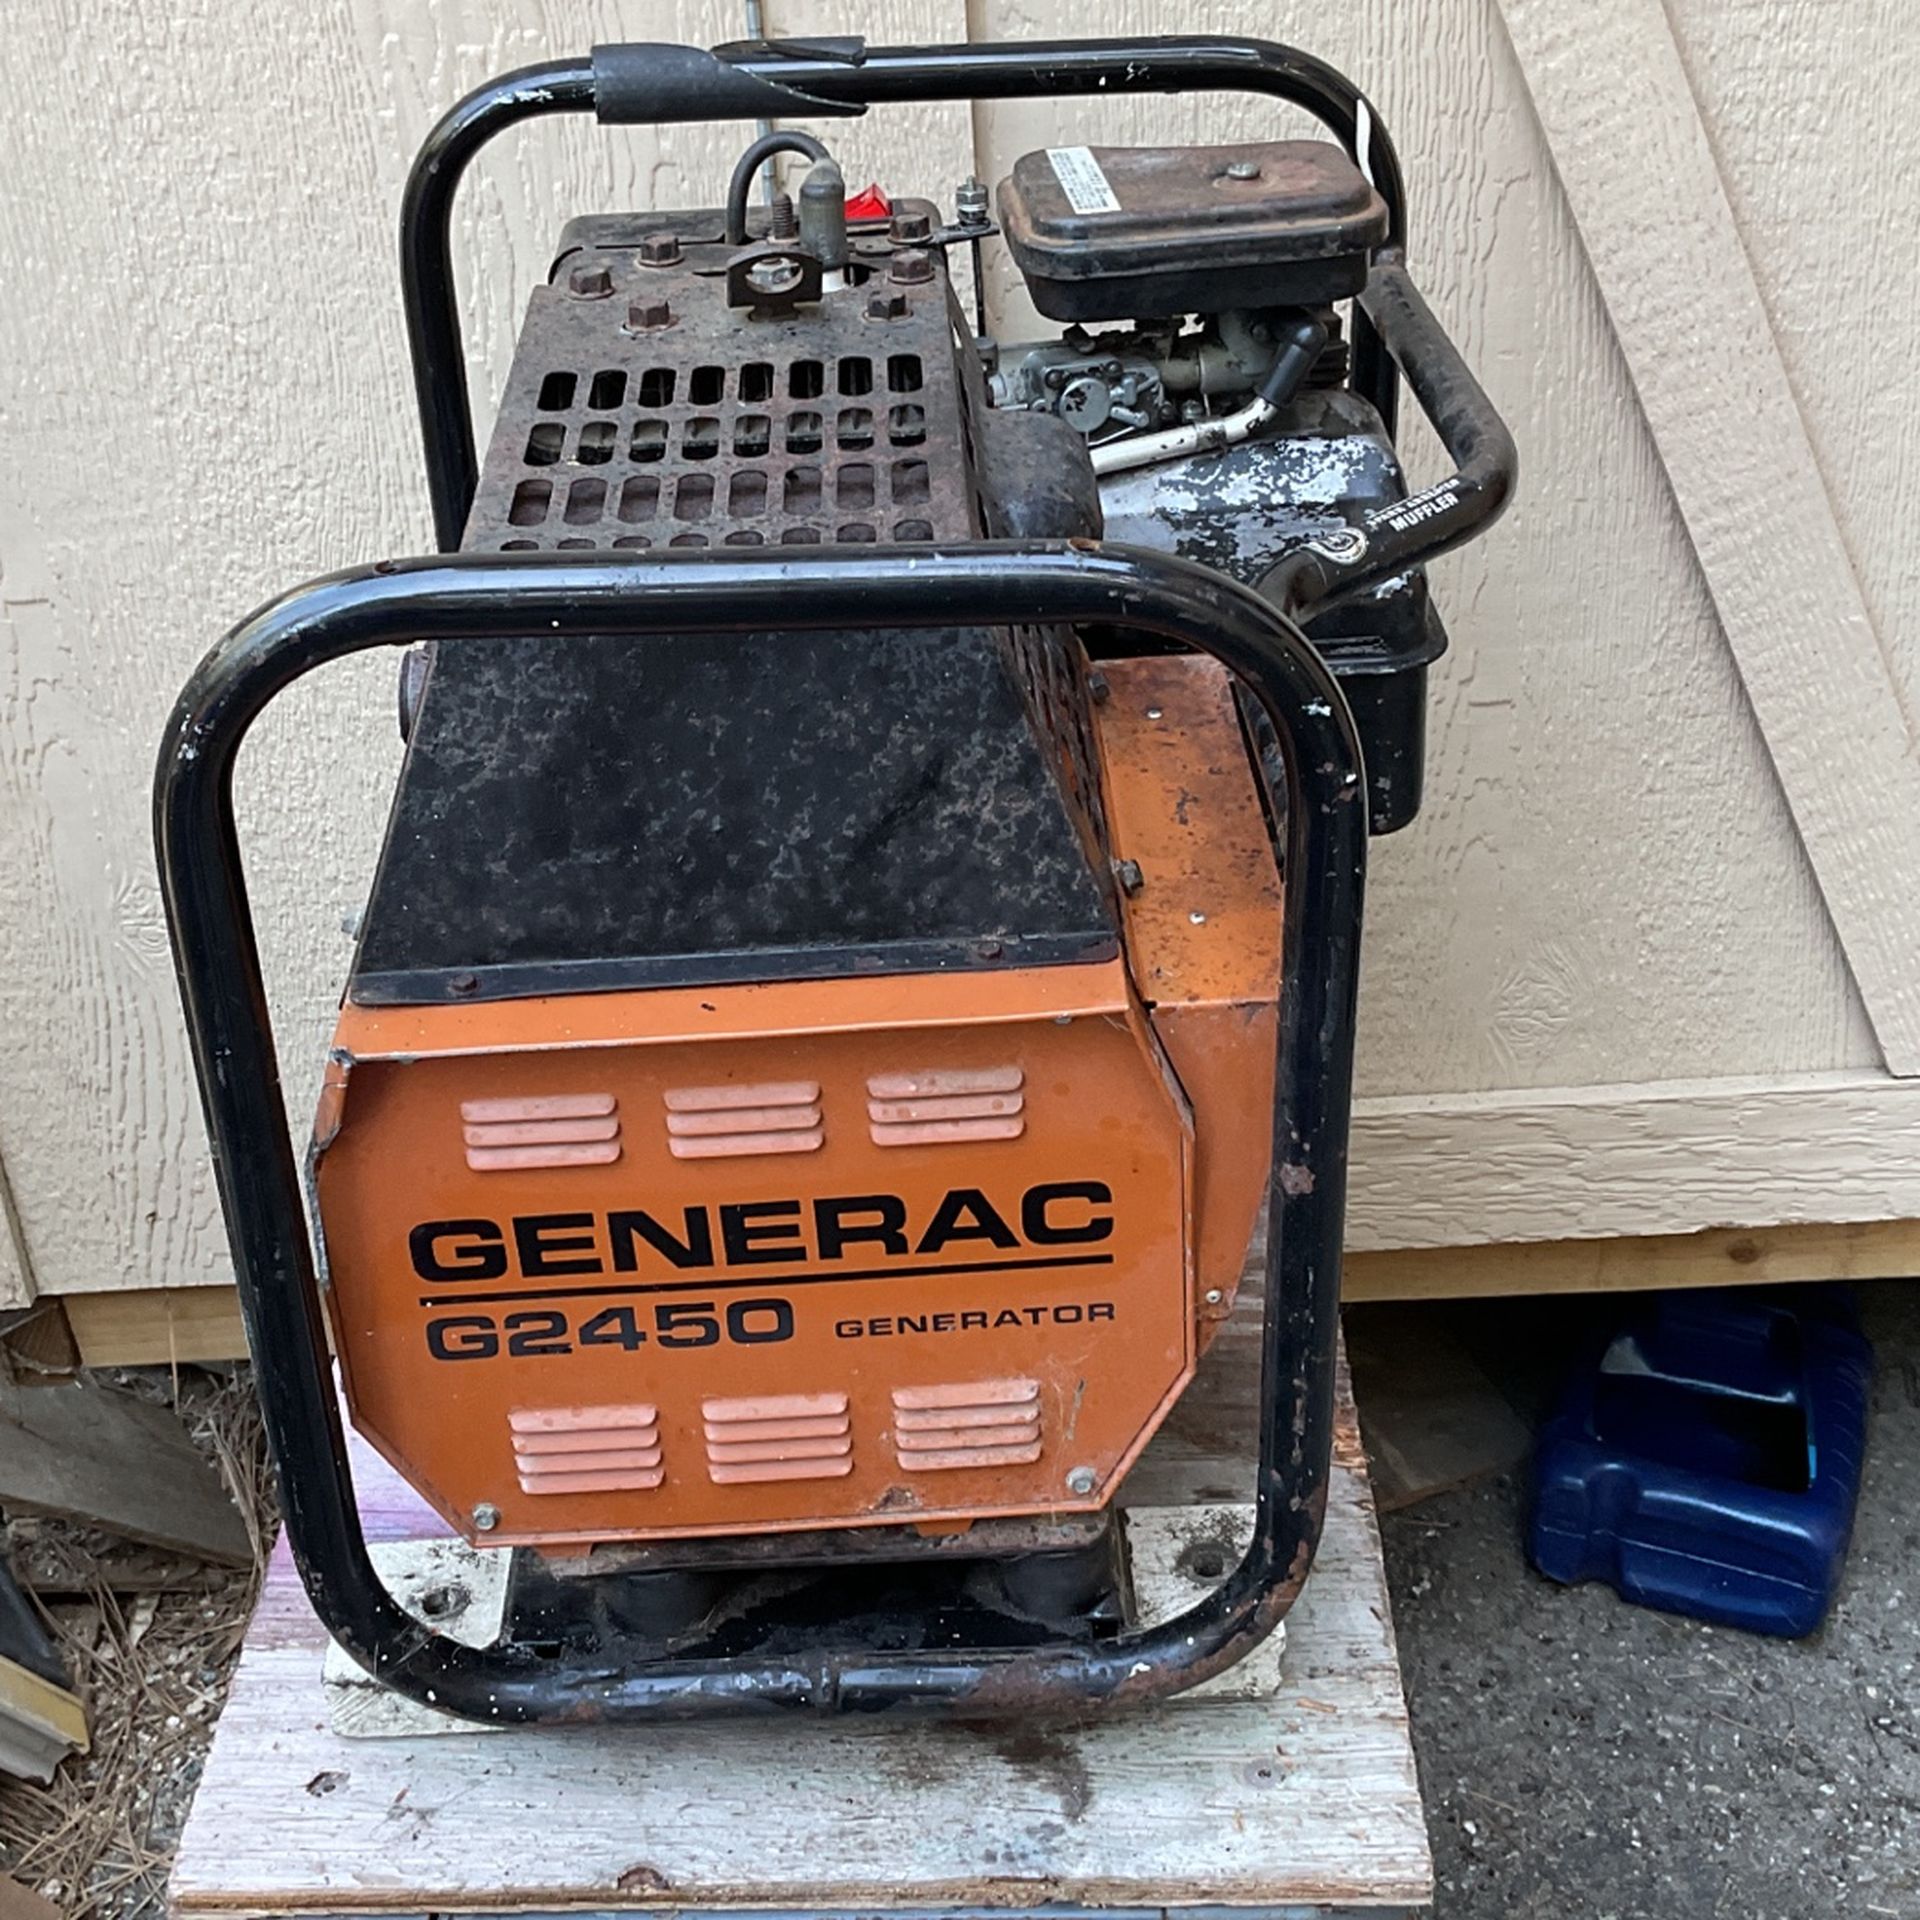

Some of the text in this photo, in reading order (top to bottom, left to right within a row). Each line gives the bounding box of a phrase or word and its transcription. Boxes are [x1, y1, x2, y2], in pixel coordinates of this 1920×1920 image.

[1389, 492, 1459, 531] MUFFLER
[409, 1181, 1114, 1282] GENERAC
[426, 1298, 1117, 1360] G2450 GENERATOR
